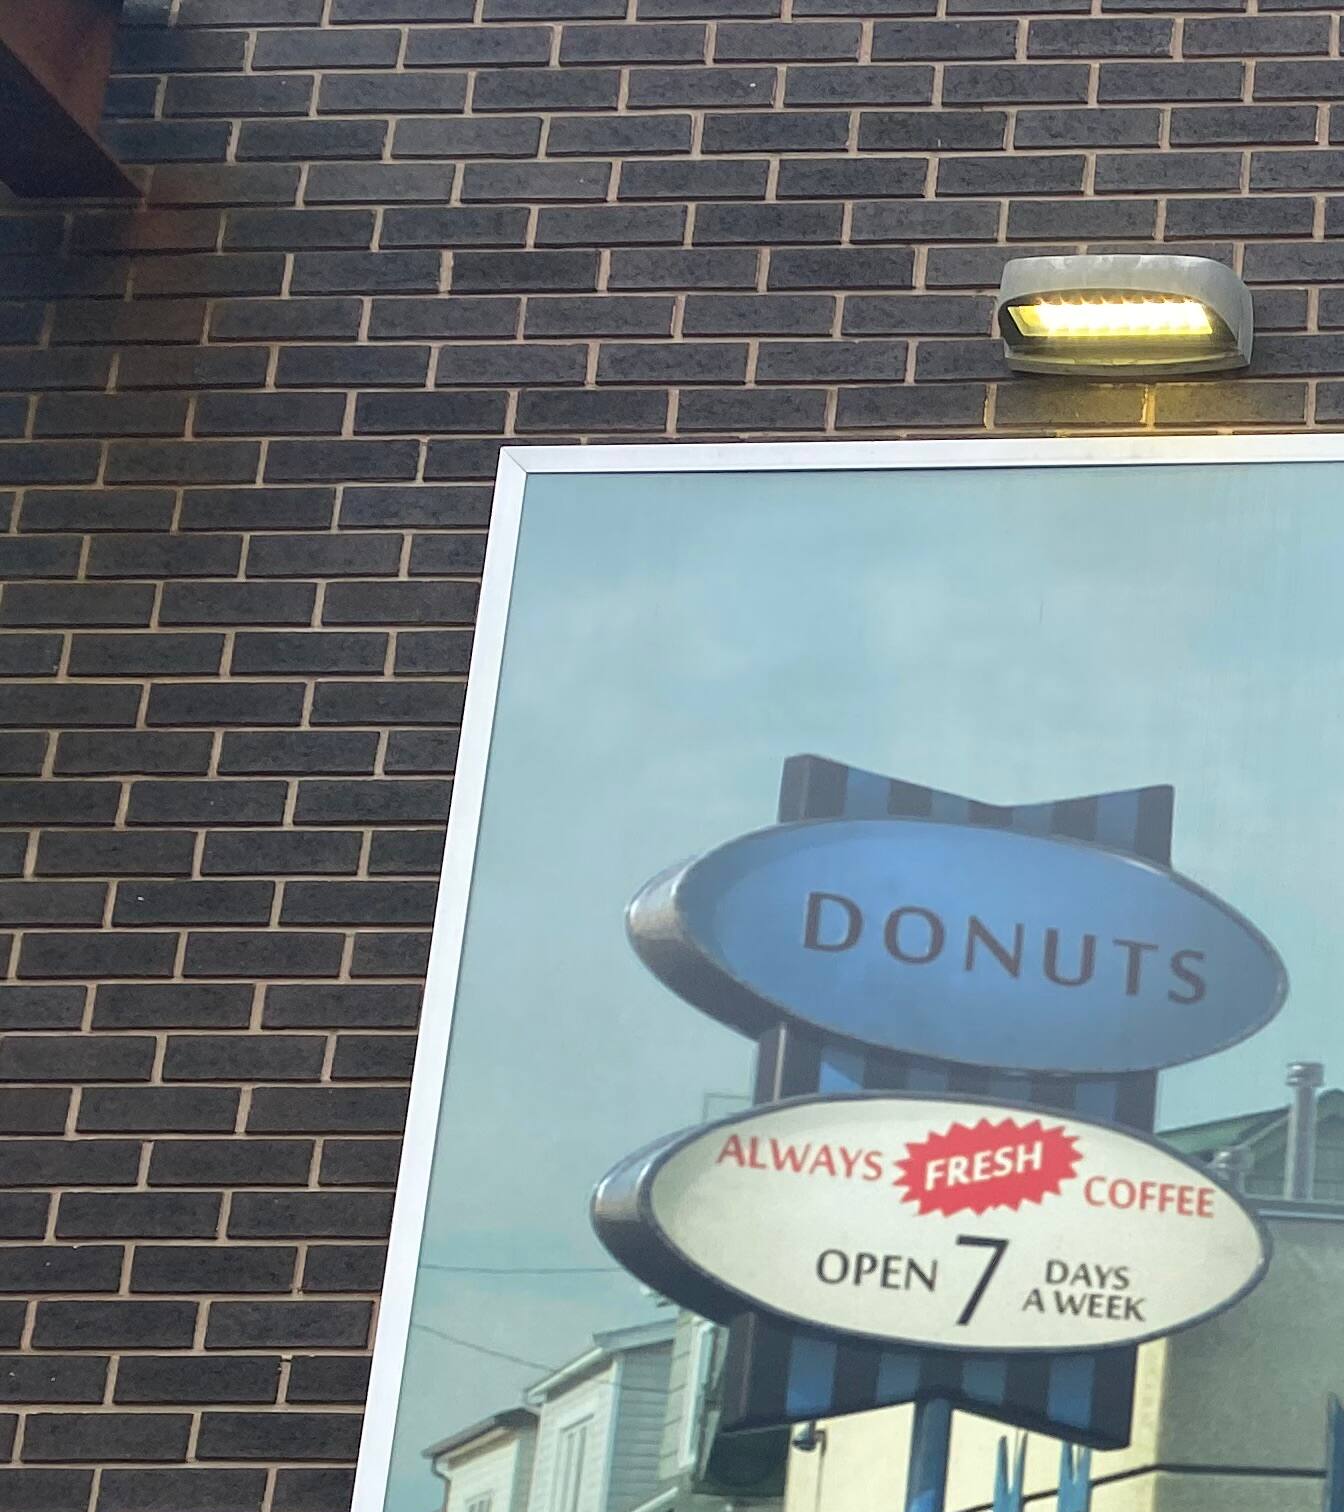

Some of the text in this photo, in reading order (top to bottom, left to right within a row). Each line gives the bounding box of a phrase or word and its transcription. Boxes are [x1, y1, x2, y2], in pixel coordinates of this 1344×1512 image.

[803, 891, 1208, 1006] DONUTS
[715, 1134, 1216, 1218] ALWAYS FRESH COFFEE
[815, 1234, 1010, 1327] OPEN 7
[1022, 1288, 1147, 1322] A WEEK
[1045, 1260, 1131, 1291] DAYS
